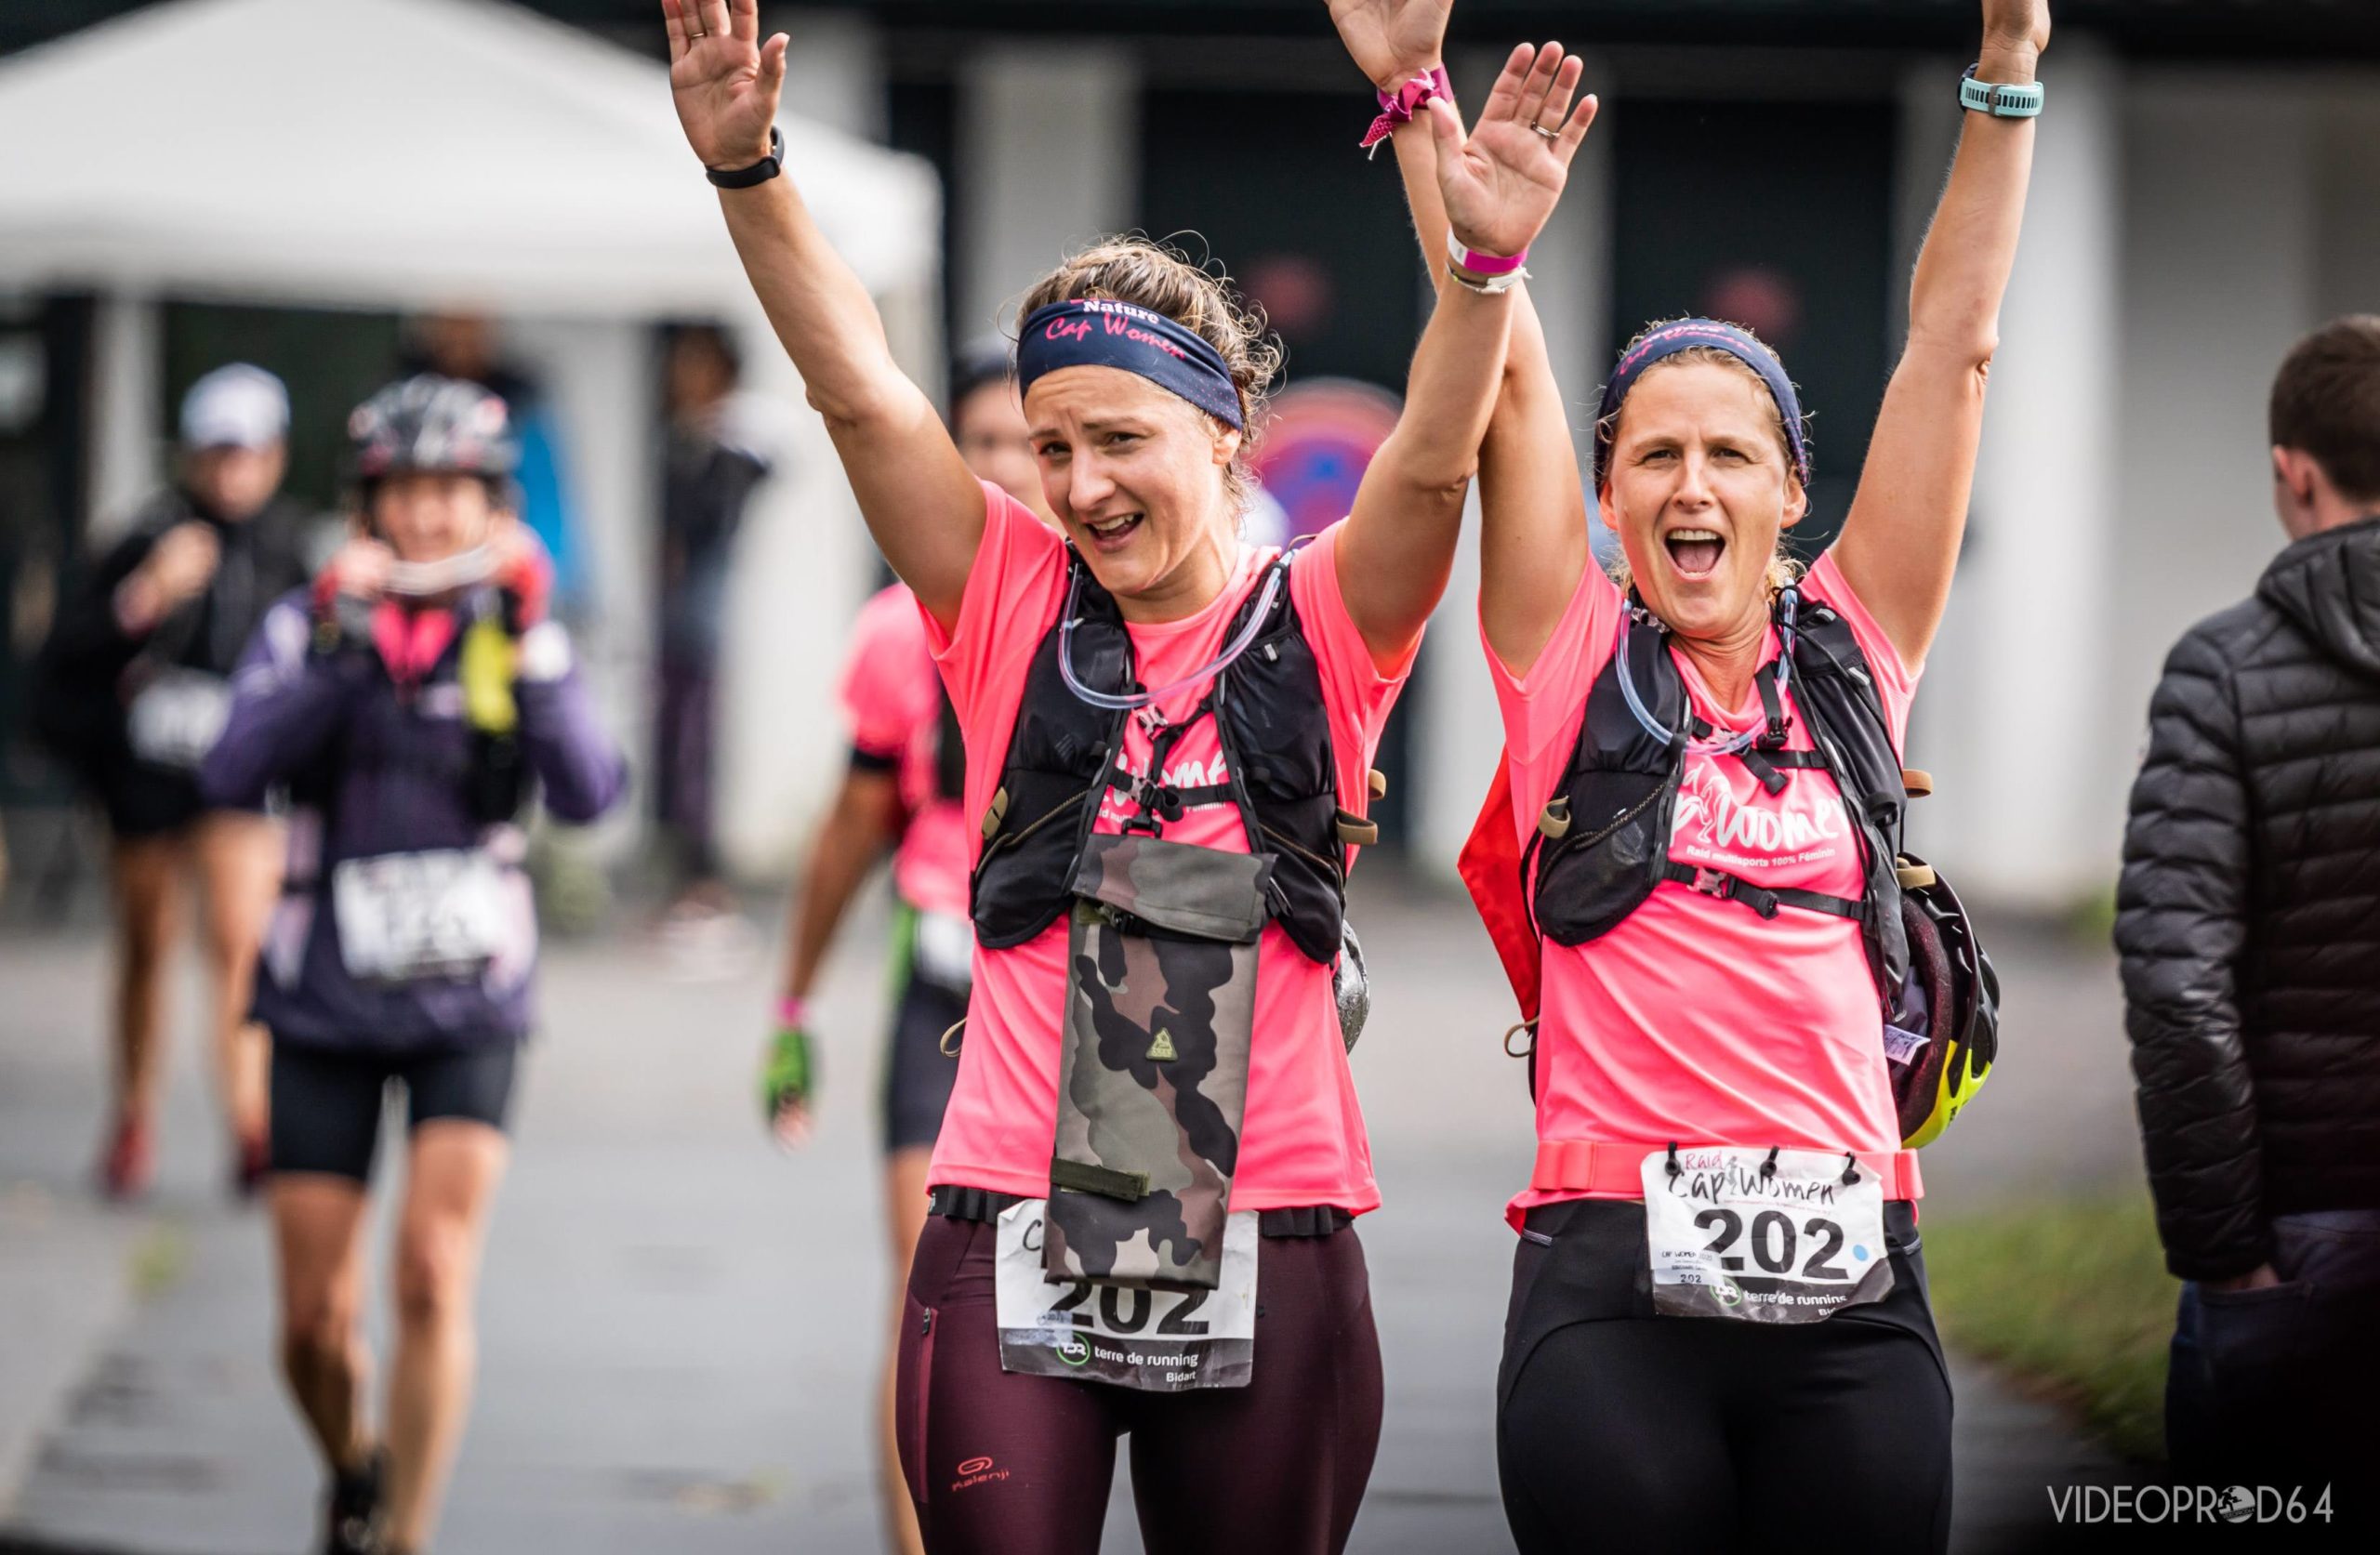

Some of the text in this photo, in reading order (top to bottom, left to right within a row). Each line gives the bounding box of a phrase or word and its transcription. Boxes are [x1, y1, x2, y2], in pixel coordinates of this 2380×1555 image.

[1083, 300, 1160, 324] Nature
[1045, 312, 1185, 359] Cap Women
[1686, 845, 1711, 859] Raid
[1712, 852, 1769, 867] multisports
[1772, 857, 1796, 865] 100%
[1685, 1151, 1726, 1170] Raid
[1668, 1167, 1834, 1205] Cap Women
[1694, 1209, 1849, 1279] 202
[1680, 1273, 1702, 1284] 202
[1094, 1346, 1199, 1367] terre de running
[1166, 1370, 1197, 1382] Bidart
